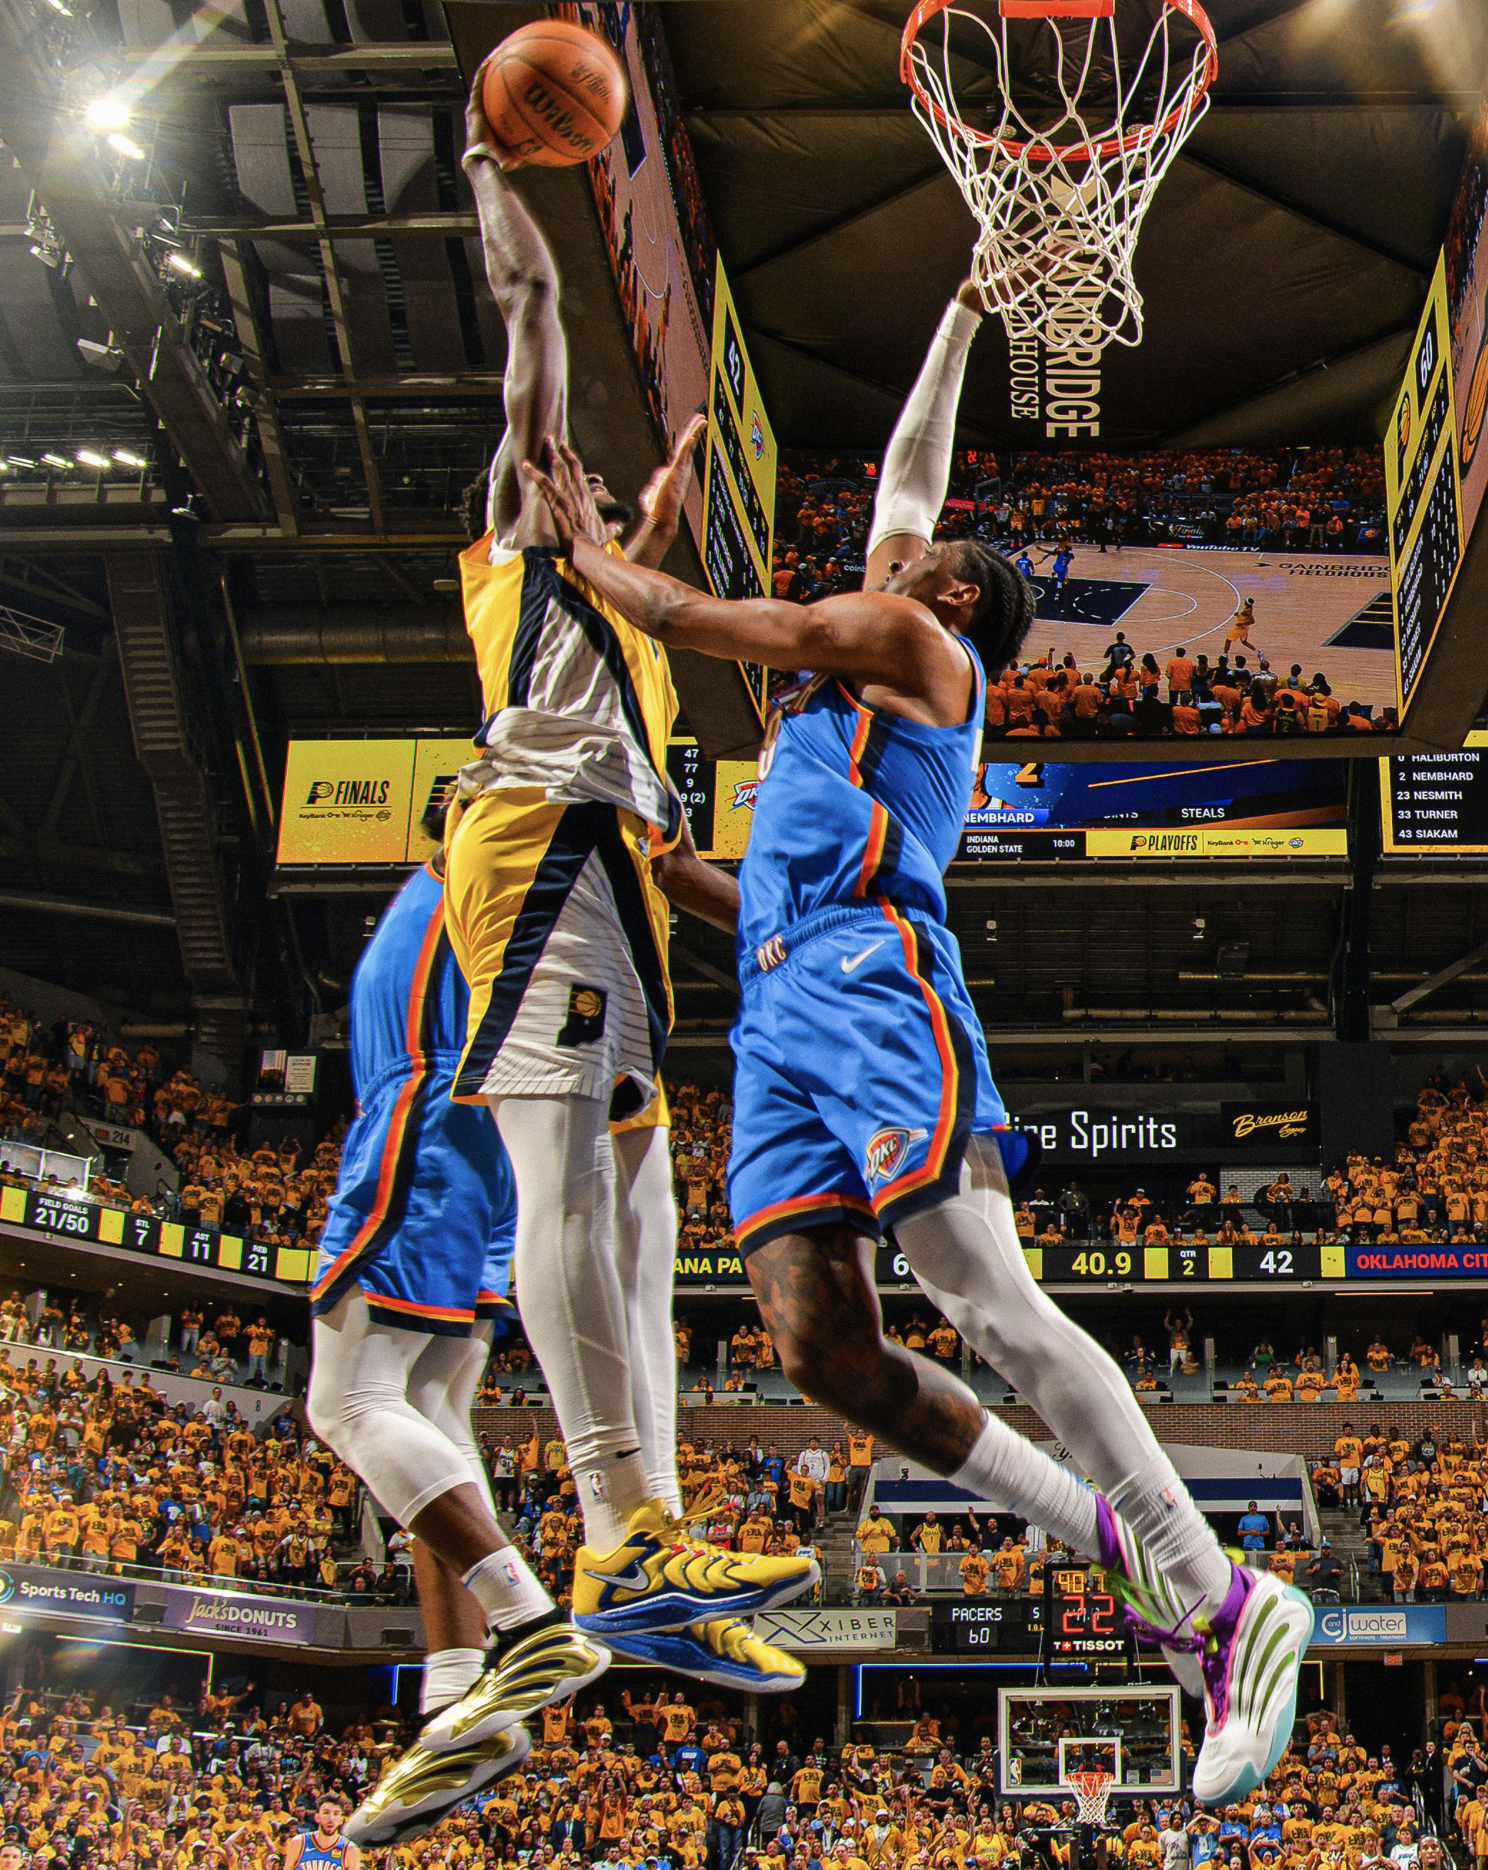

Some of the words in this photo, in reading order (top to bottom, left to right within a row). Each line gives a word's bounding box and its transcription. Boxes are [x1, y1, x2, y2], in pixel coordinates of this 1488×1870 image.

[1420, 331, 1433, 387] 60
[684, 749, 699, 758] 47
[1411, 753, 1480, 762] HALIBURTON
[683, 764, 698, 773] 77
[1398, 772, 1406, 781] 2
[1412, 772, 1474, 781] NEMBHARD
[686, 779, 694, 788] 9
[334, 780, 391, 805] FINALS
[690, 793, 706, 804] (2)
[1397, 791, 1410, 800] 23
[1413, 791, 1463, 800] NESMITH
[1181, 808, 1225, 818] STEALS
[1397, 810, 1411, 819] 33
[1415, 810, 1458, 819] TURNER
[966, 835, 999, 844] INDIANA
[1398, 829, 1412, 838] 43
[1415, 829, 1458, 838] SIAKAM
[966, 845, 997, 853] GOLDEN
[999, 845, 1023, 853] STATE
[1053, 839, 1075, 848] 10:00
[1148, 835, 1198, 851] PLAYOFFS
[1207, 840, 1234, 848] KeyBank
[756, 933, 787, 973] OKC
[1232, 1110, 1308, 1137] Branson
[112, 1130, 131, 1145] 214
[1071, 1111, 1177, 1157] Spirits
[869, 1138, 898, 1177] OKC
[39, 1197, 62, 1209] FIELD
[62, 1202, 89, 1215] GOALS
[34, 1207, 89, 1233] 21/50
[135, 1219, 150, 1229] STL
[135, 1229, 148, 1246] 7
[194, 1232, 210, 1241] AST
[191, 1241, 211, 1260] 11
[252, 1245, 268, 1254] REB
[1180, 1250, 1197, 1259] QTR
[247, 1254, 268, 1272] 21
[673, 1258, 712, 1274] ANA
[717, 1258, 743, 1274] PA
[1072, 1252, 1132, 1275] 40.9
[1182, 1259, 1195, 1276] 2
[1260, 1250, 1294, 1274] 42
[1356, 1253, 1459, 1270] OKLAHOMA
[20, 1582, 67, 1601] Sports
[68, 1588, 100, 1603] Tech
[102, 1592, 126, 1606] HQ
[227, 1603, 298, 1629] DONUTS
[951, 1606, 1003, 1622] PACERS
[1062, 1595, 1114, 1633] 22
[214, 1623, 243, 1634] SINCE
[245, 1627, 269, 1637] 1961
[819, 1617, 895, 1633] XIBER
[1350, 1615, 1404, 1631] water
[829, 1630, 894, 1643] INTERNET
[1072, 1640, 1124, 1651] TISSOT
